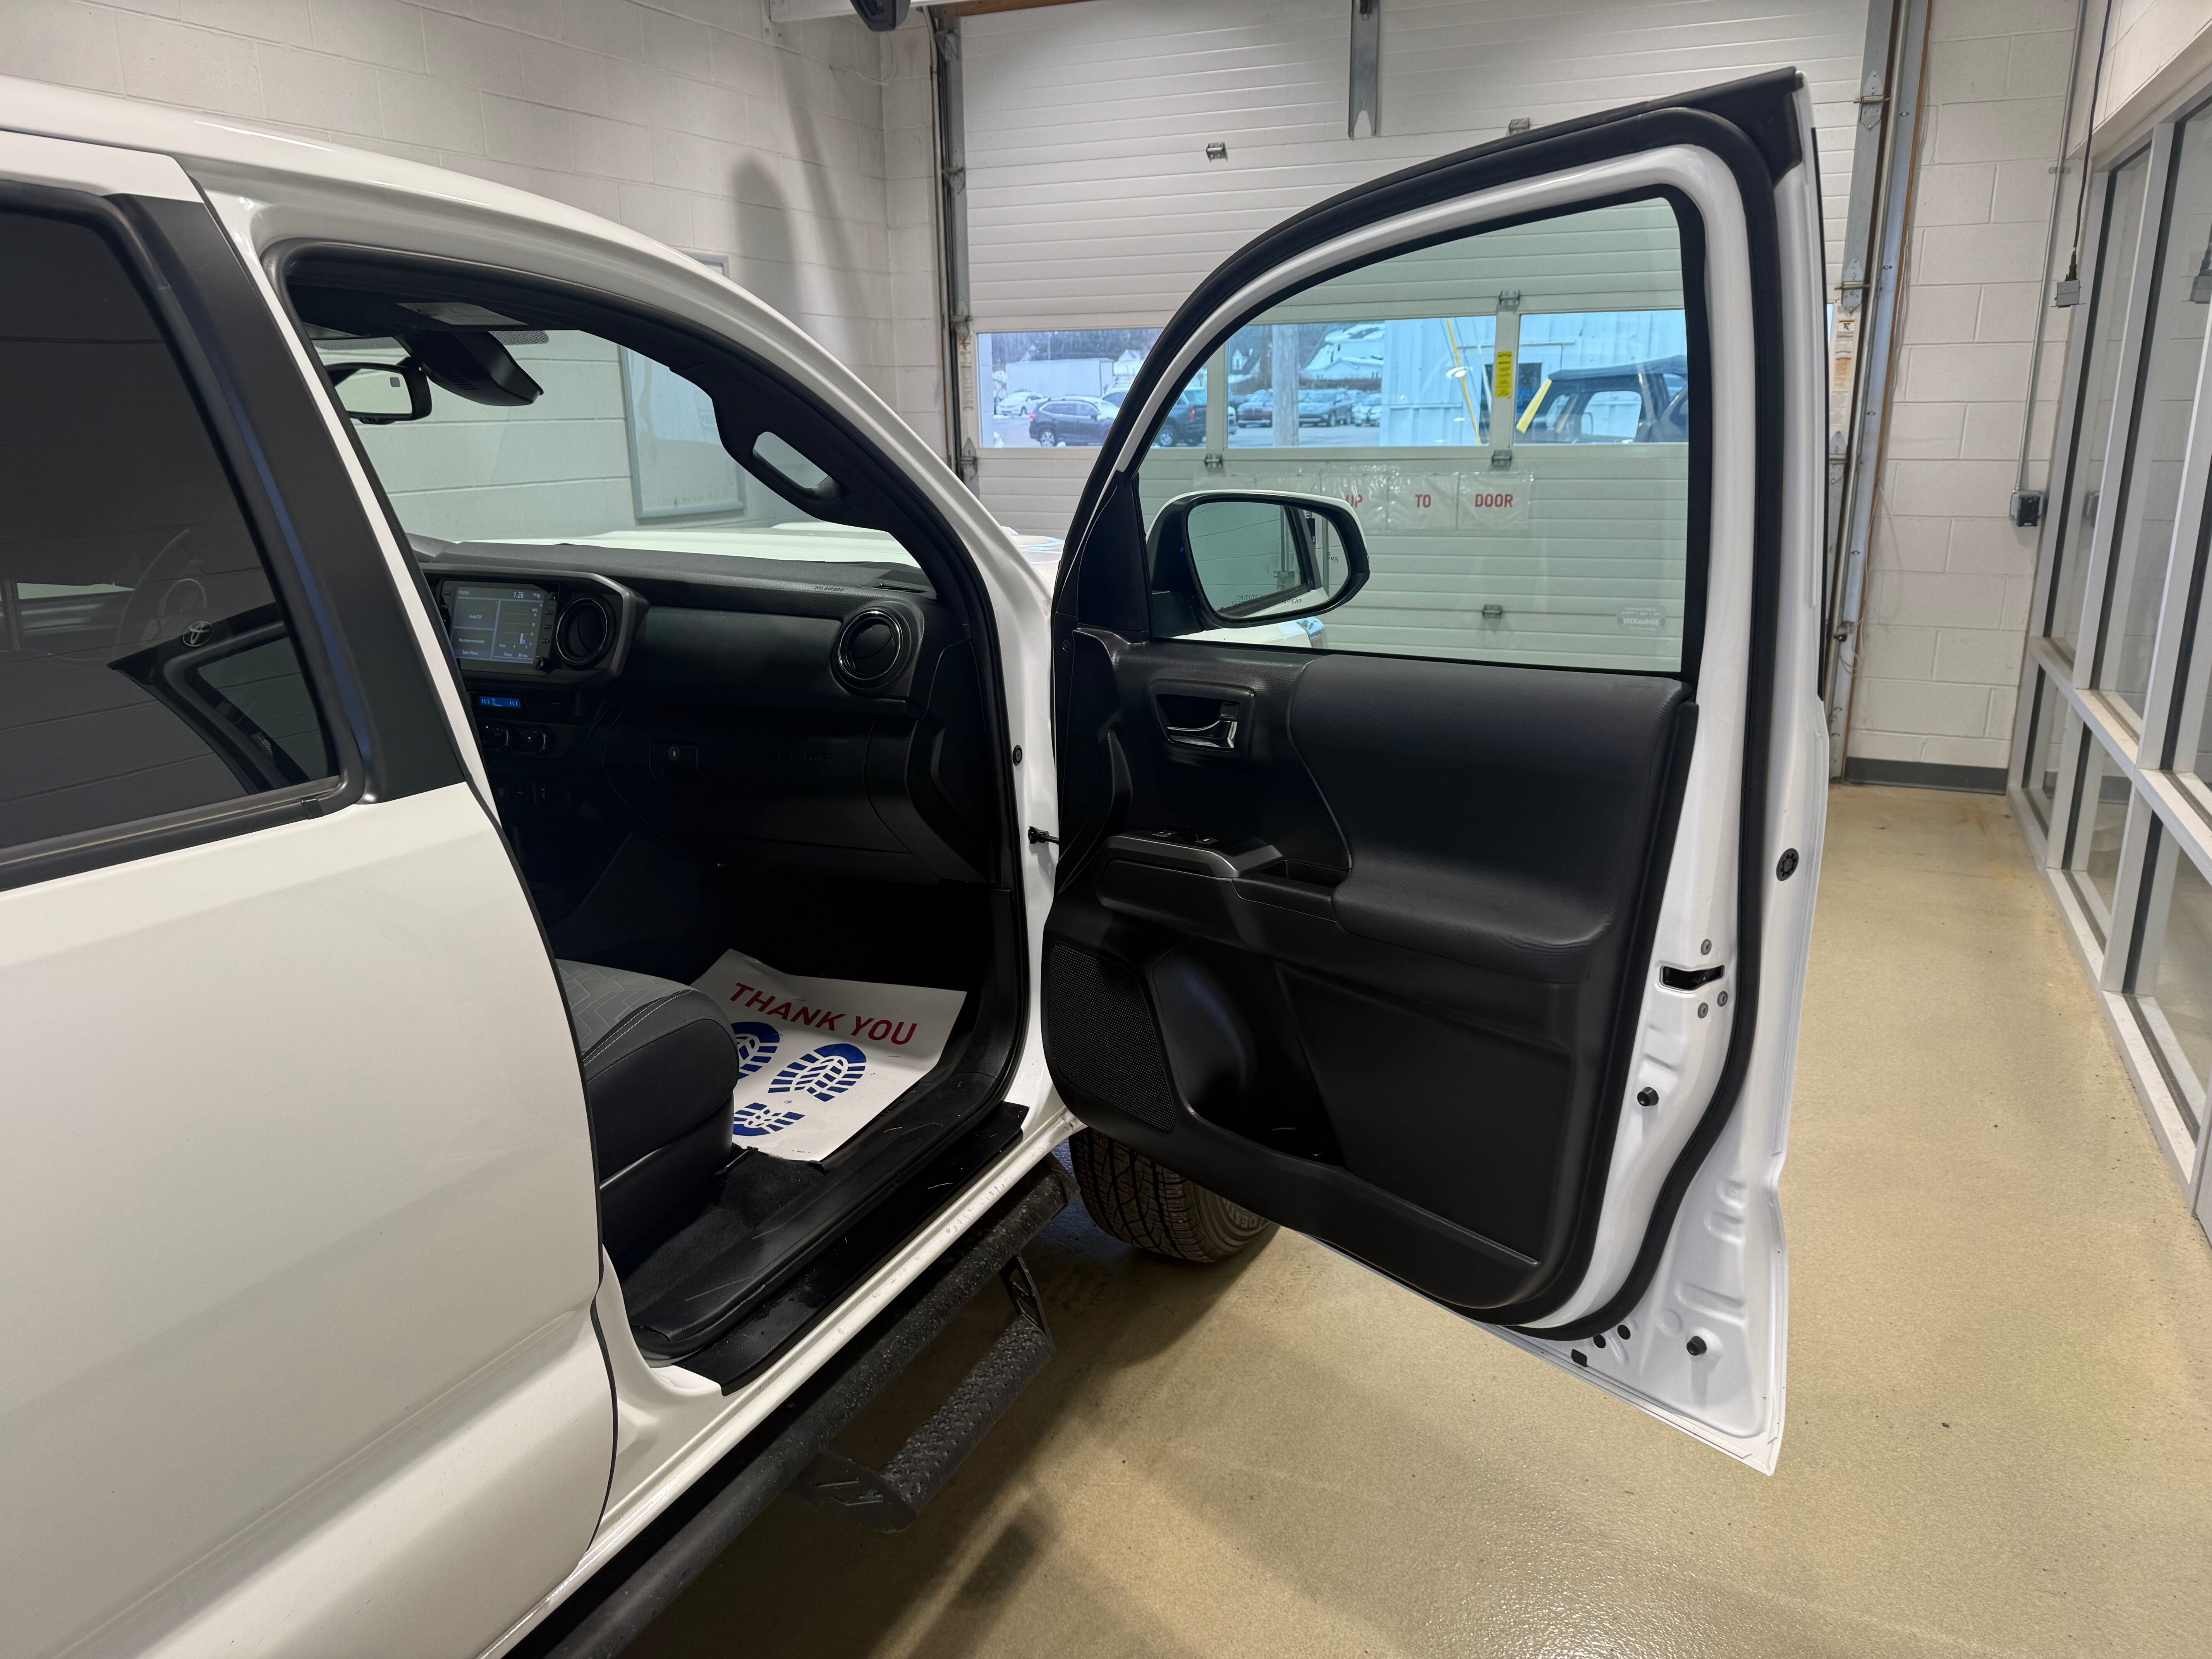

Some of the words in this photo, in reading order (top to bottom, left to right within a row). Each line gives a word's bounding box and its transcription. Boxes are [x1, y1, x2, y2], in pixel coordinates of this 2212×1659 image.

[1415, 494, 1432, 508] TO
[1475, 494, 1513, 508] DOOR
[730, 982, 846, 1031] THANK
[850, 1015, 917, 1045] YOU
